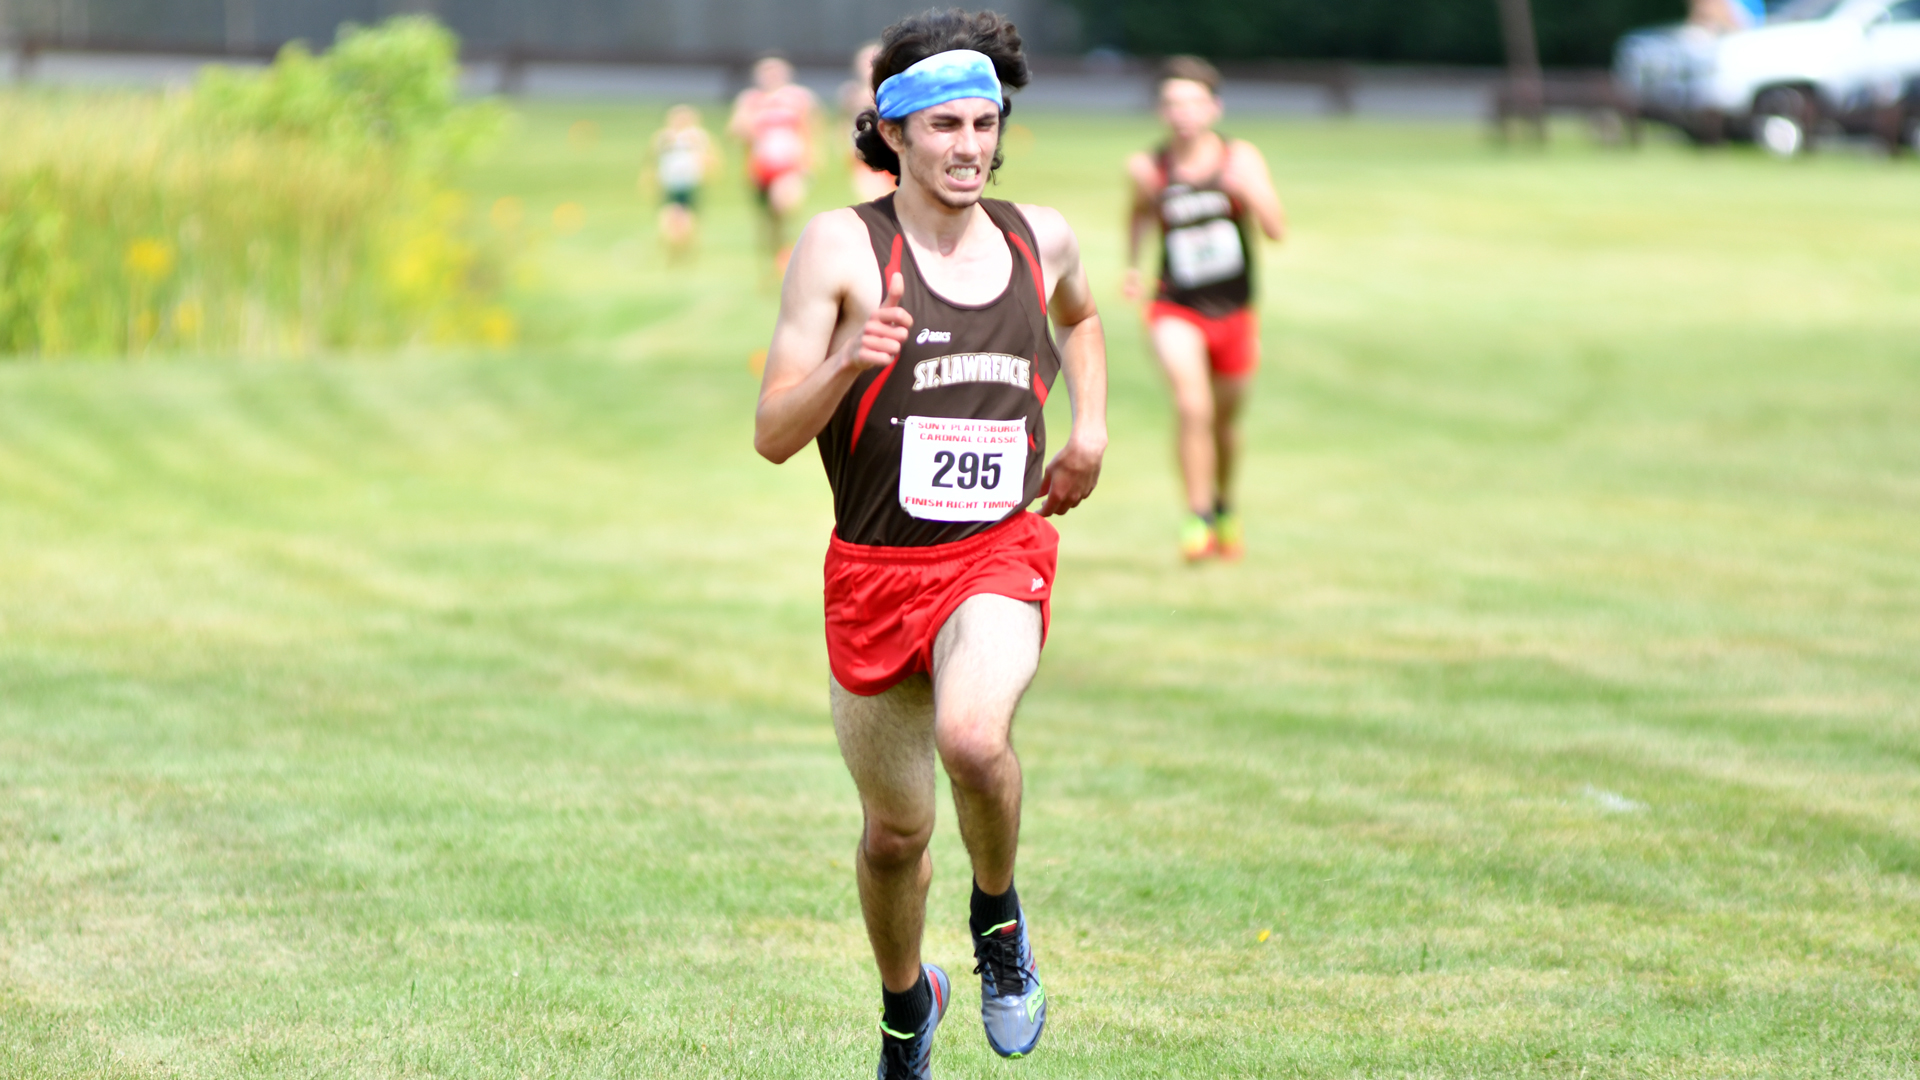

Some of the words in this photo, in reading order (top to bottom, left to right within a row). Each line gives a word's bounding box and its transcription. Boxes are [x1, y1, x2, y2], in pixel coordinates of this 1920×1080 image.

[918, 421, 946, 431] SUNY
[919, 432, 973, 444] CARDINAL
[976, 435, 1018, 444] CLASSIC
[931, 450, 1003, 490] 295
[905, 496, 943, 508] FINISH
[946, 500, 979, 509] RIGHT
[982, 500, 1018, 509] TIMING
